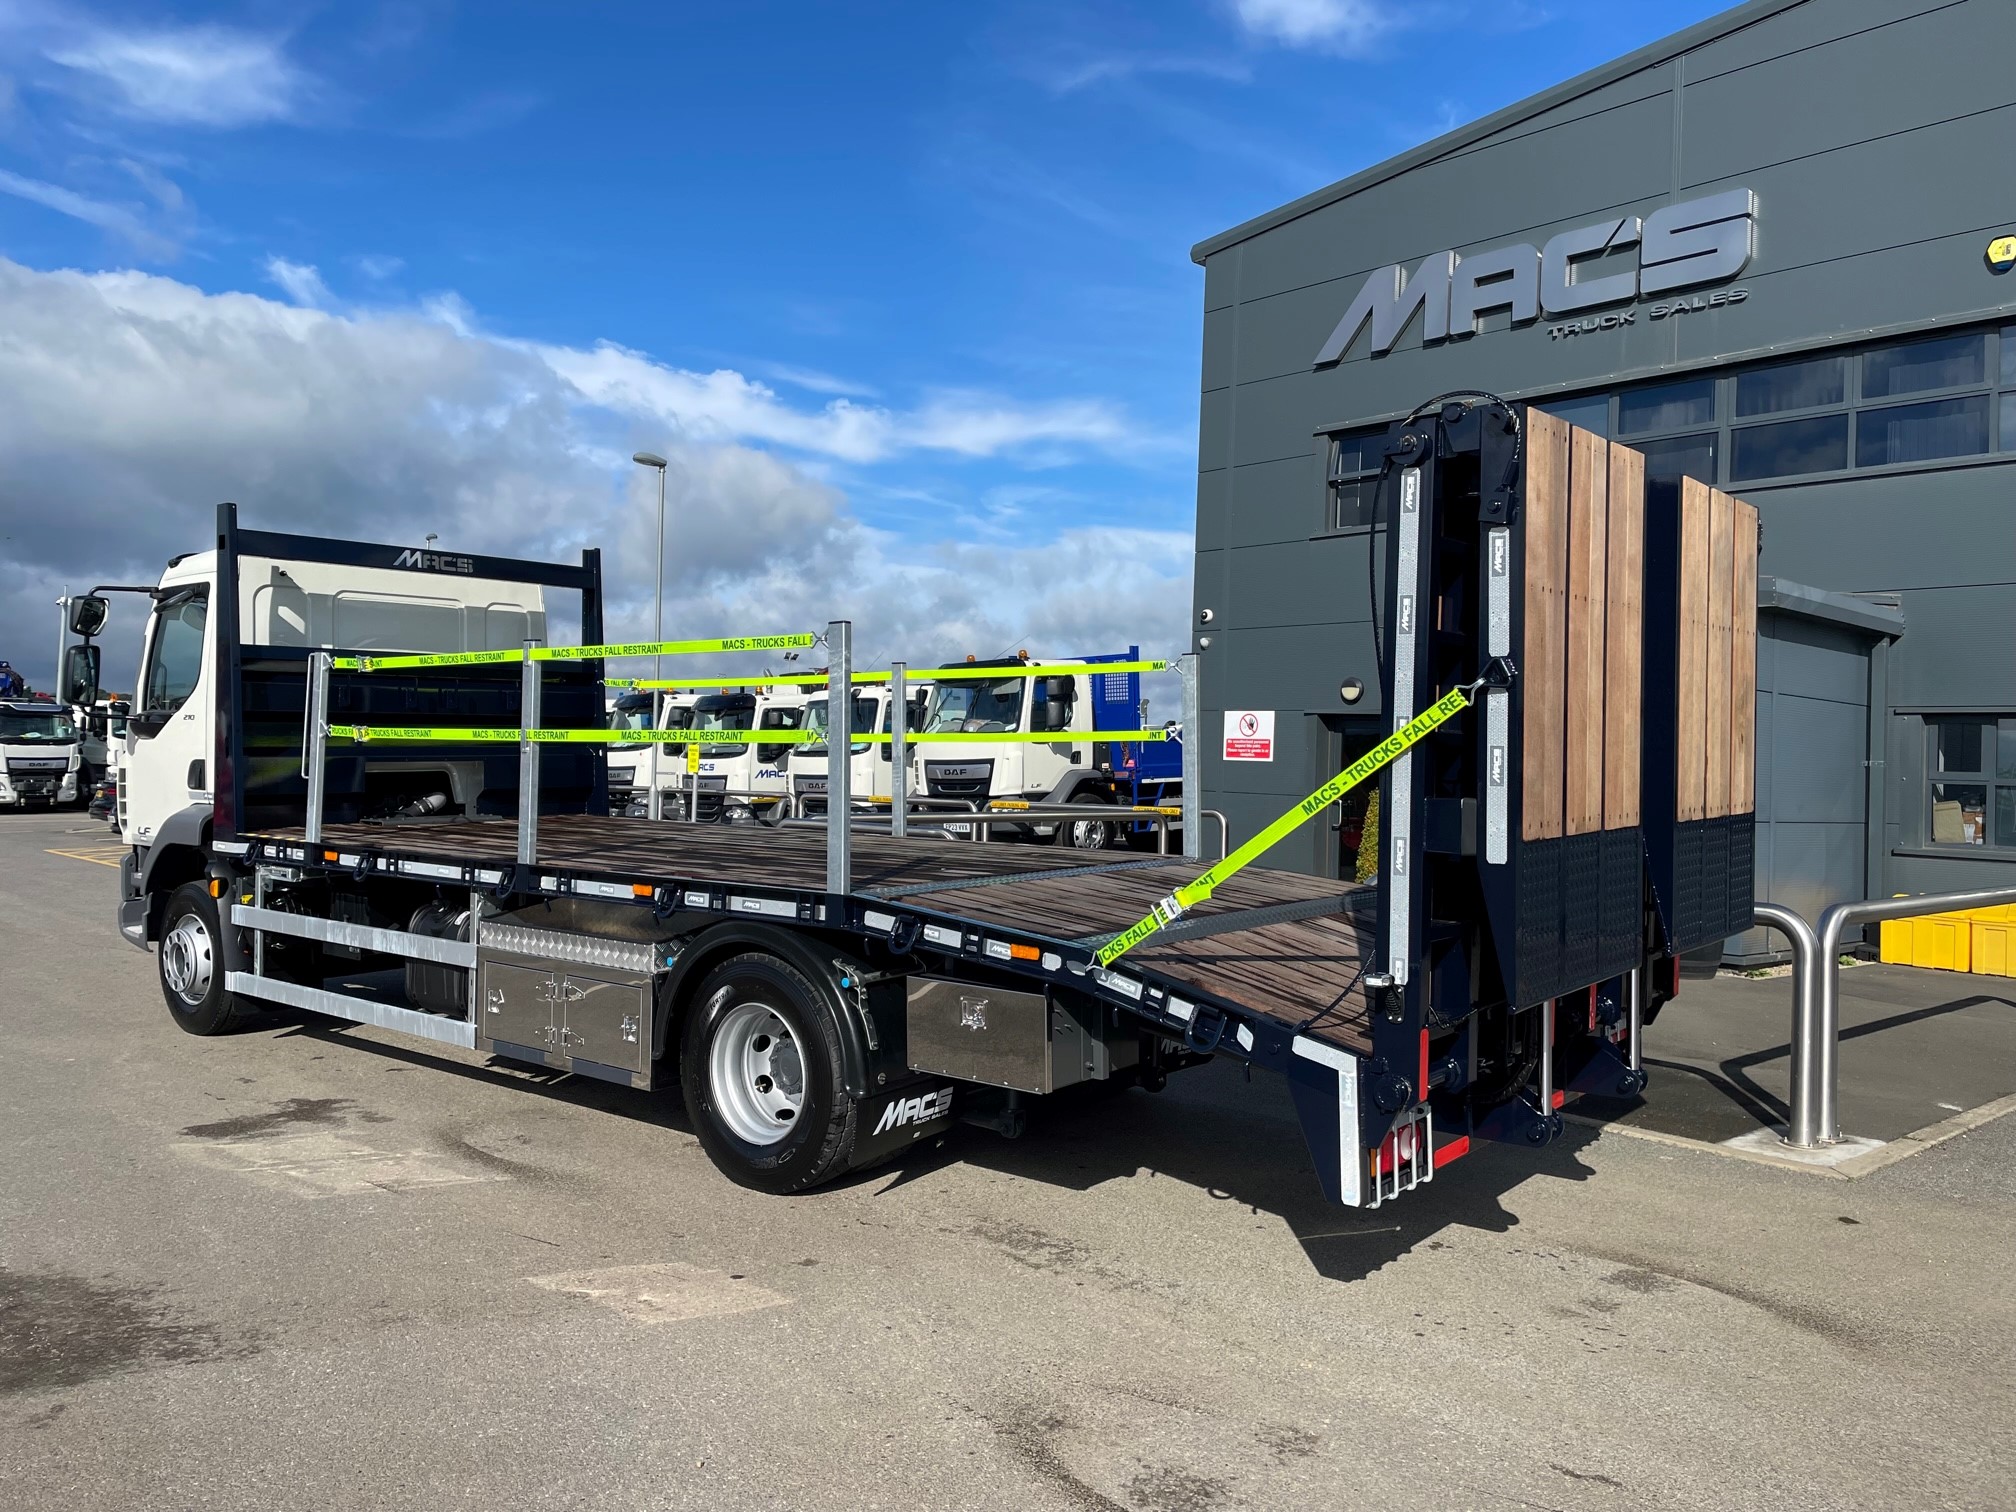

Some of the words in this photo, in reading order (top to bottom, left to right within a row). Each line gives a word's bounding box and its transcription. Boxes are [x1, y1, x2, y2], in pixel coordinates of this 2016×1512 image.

[1313, 187, 1756, 367] MACS
[1547, 310, 1636, 340] TRUCK
[1650, 288, 1749, 320] SALES
[393, 549, 474, 573] MACS
[551, 649, 570, 658] MACS
[575, 647, 603, 657] TRUCKS
[604, 646, 622, 656] FALL
[623, 644, 664, 656] RESTRAINT
[722, 639, 745, 650] MACS
[751, 637, 785, 649] TRUCKS
[787, 636, 808, 647] FALL
[419, 656, 434, 664] MACS
[438, 655, 459, 664] TRUCKS
[460, 654, 473, 663] FALL
[475, 652, 505, 662] RESTRAINT
[472, 730, 488, 739] MACS
[493, 730, 516, 739] TRUCKS
[517, 731, 532, 739] FLL
[533, 731, 570, 739] RESTRAINT
[621, 731, 642, 740] MACS
[647, 731, 677, 741] TRUCKS
[679, 731, 697, 741] FALL
[699, 731, 743, 741] RESTRAINT
[1301, 782, 1341, 816] MACS
[1345, 737, 1403, 782] TRUCKS
[1402, 715, 1441, 743] FALL
[138, 826, 151, 835] LF
[1125, 921, 1154, 945] FALL
[872, 1086, 954, 1136] MACS
